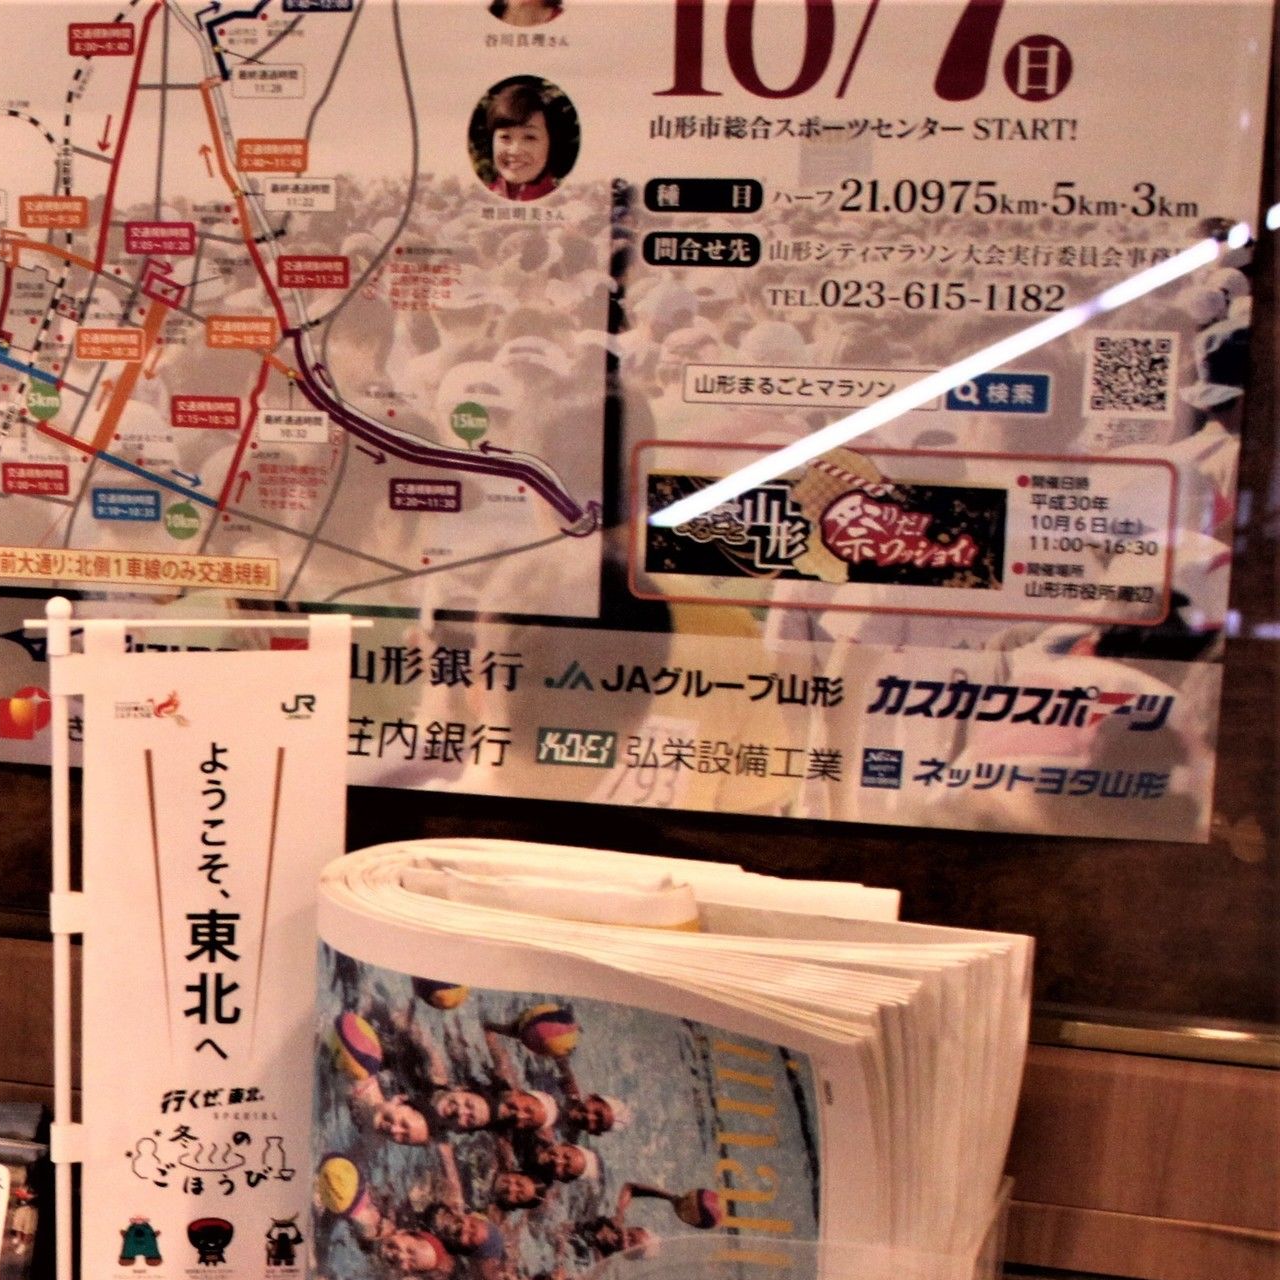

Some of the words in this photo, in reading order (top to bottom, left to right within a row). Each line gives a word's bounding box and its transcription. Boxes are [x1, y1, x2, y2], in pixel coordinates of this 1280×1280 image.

[649, 116, 965, 143] 山形市総合スポーツセンター
[973, 116, 1078, 142] START!
[772, 189, 836, 210] ハーフ
[652, 236, 753, 264] 問合せ先
[768, 239, 1188, 271] 山形シティマラソン大会実行委員会事務
[768, 279, 1066, 313] TEL.023-615-1182
[694, 374, 897, 399] 山形まるごとマラソン
[985, 384, 1036, 405] 検索
[1029, 493, 1109, 512] 平成30年
[348, 645, 525, 693] 山形銀行
[601, 665, 846, 709] JAグループ山形
[281, 694, 316, 714] JR
[866, 674, 1175, 733] カスカワスポーツ
[626, 737, 844, 783] 弘栄設備工業
[912, 757, 1171, 801] ネッツトヨタ山形
[184, 741, 243, 1060] ようこそ、東北へ
